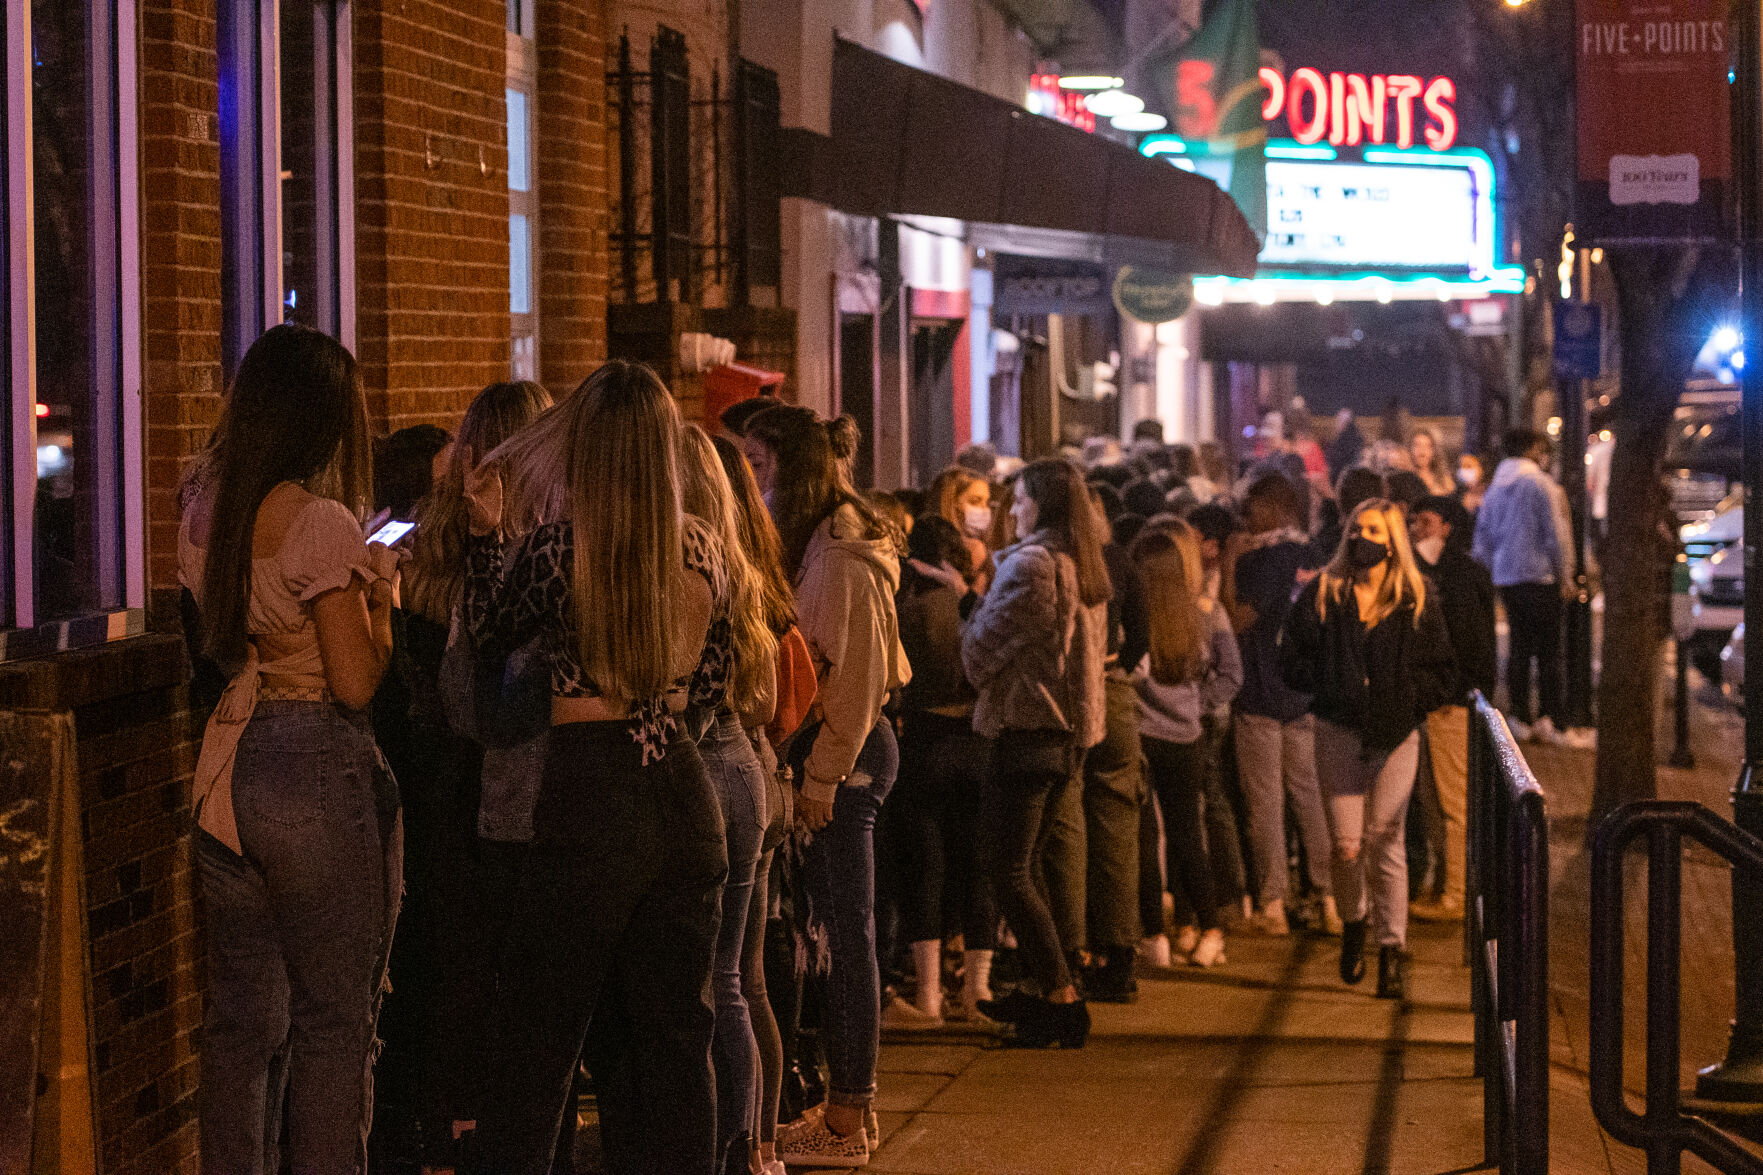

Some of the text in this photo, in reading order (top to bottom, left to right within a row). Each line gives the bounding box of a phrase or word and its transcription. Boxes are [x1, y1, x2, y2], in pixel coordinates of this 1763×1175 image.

[1582, 21, 1724, 54] FIVE POINTS
[1176, 59, 1215, 138] 5
